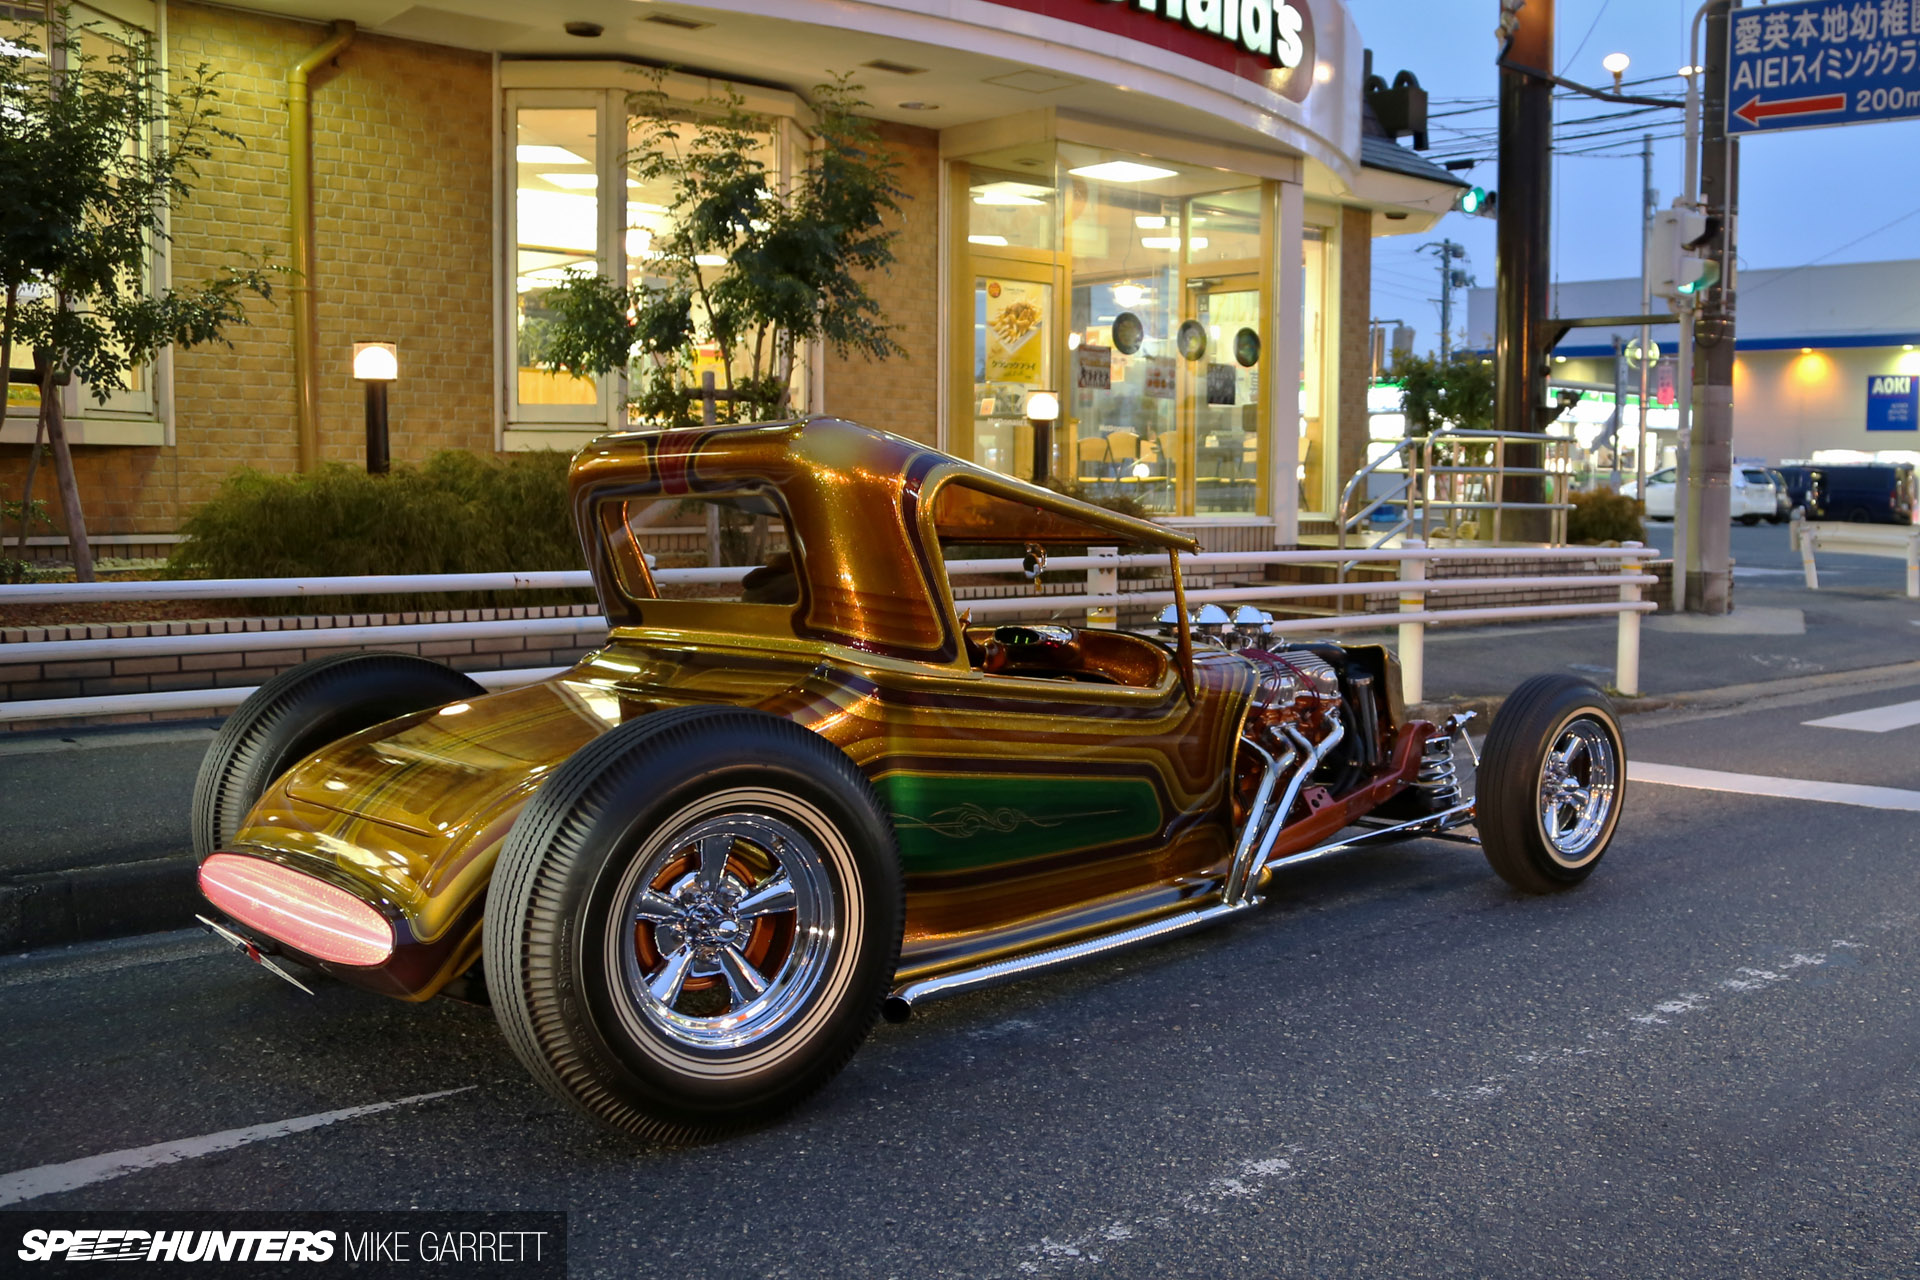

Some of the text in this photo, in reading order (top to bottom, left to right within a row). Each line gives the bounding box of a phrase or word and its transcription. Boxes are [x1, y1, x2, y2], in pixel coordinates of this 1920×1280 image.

[1733, 40, 1920, 91] AIEIスイミングクラ
[1856, 87, 1920, 112] 200m
[1872, 376, 1911, 395] AOKI
